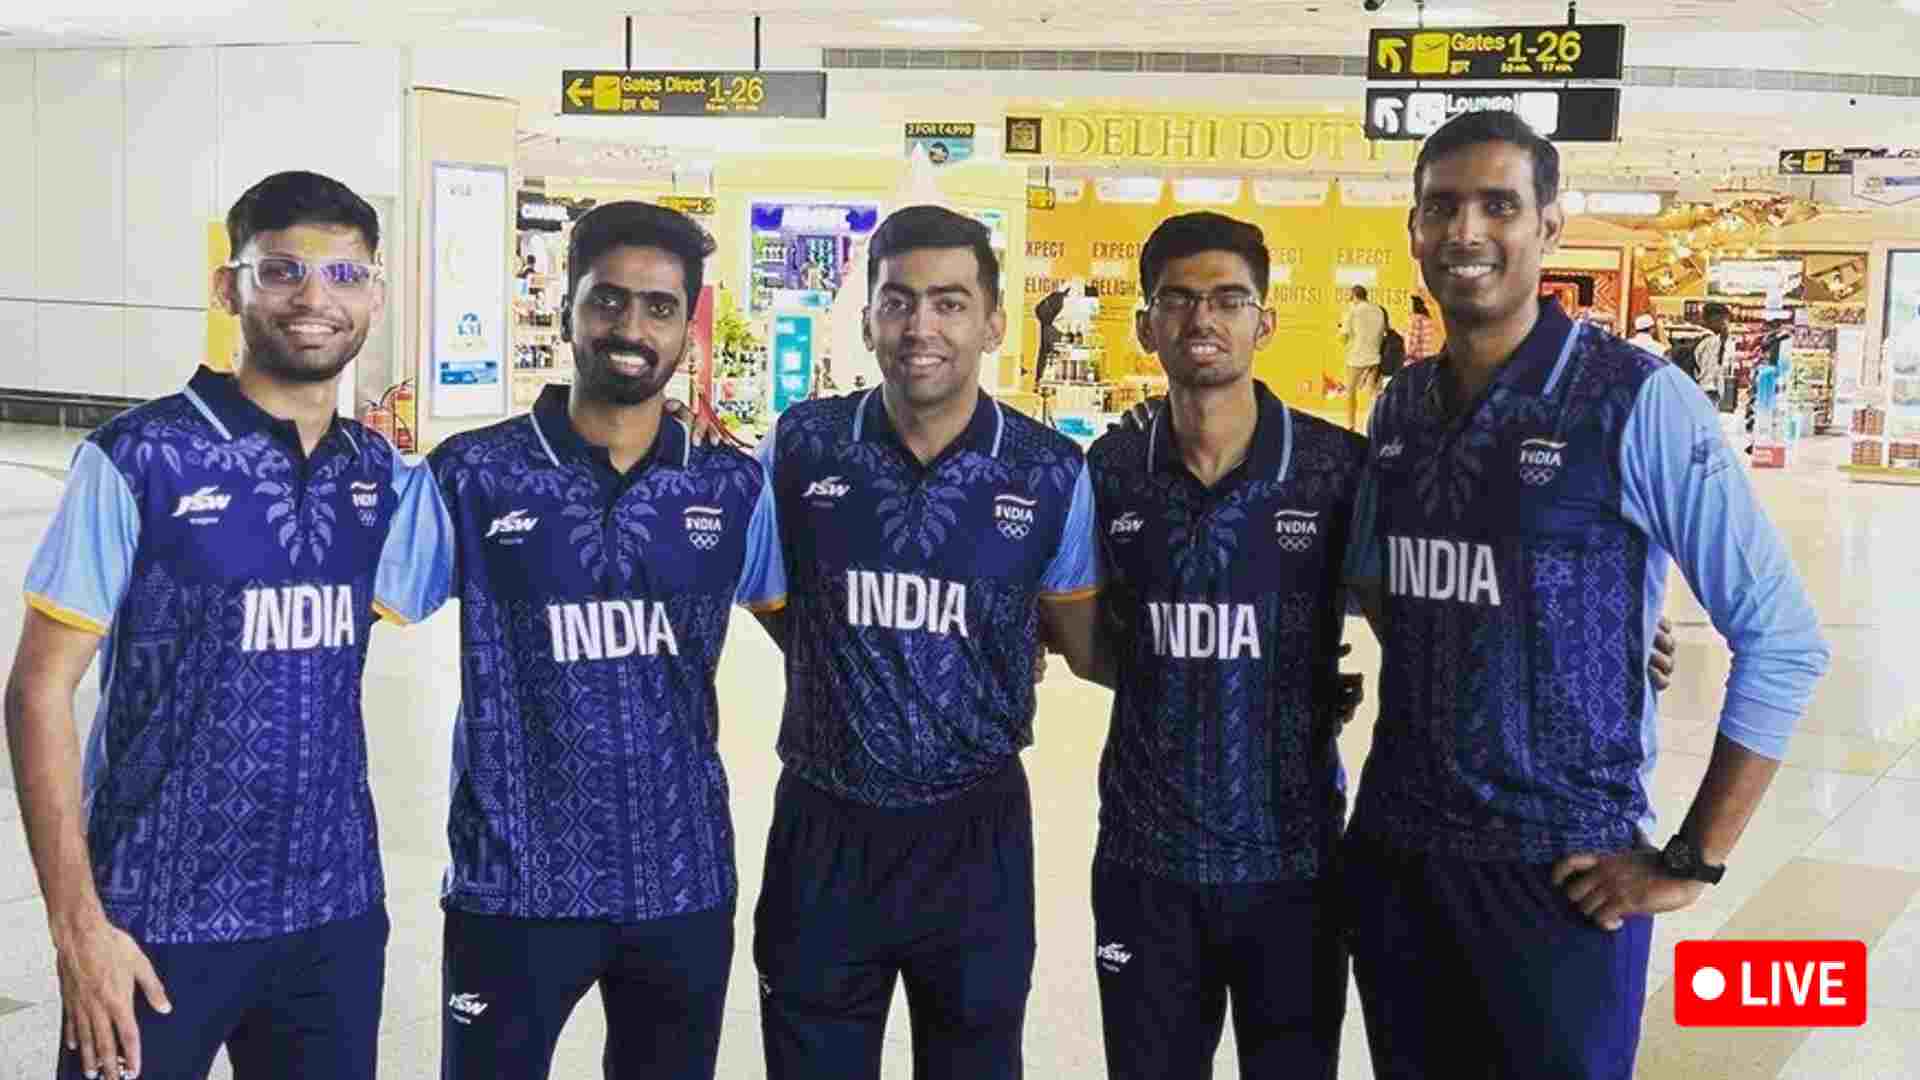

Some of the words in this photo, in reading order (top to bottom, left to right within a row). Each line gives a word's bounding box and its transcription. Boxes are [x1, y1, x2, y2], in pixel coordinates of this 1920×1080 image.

[1450, 32, 1505, 51] Gates
[1507, 31, 1582, 62] 1-26
[623, 76, 661, 92] Gates
[664, 76, 705, 92] Direct
[709, 76, 764, 103] 1-26
[1058, 117, 1219, 158] DELHI
[1025, 240, 1065, 257] XPECT
[1336, 249, 1393, 265] EXPECT
[802, 481, 850, 498] JSW
[685, 516, 722, 531] INDIA
[994, 504, 1033, 523] INDIA
[1275, 520, 1317, 534] INDIA
[485, 517, 539, 538] JSW
[1387, 535, 1501, 606] INDIA
[846, 569, 969, 638] INDIA
[241, 584, 355, 652] INDIA
[546, 600, 680, 662] INDIA
[1148, 602, 1262, 660] INDIA
